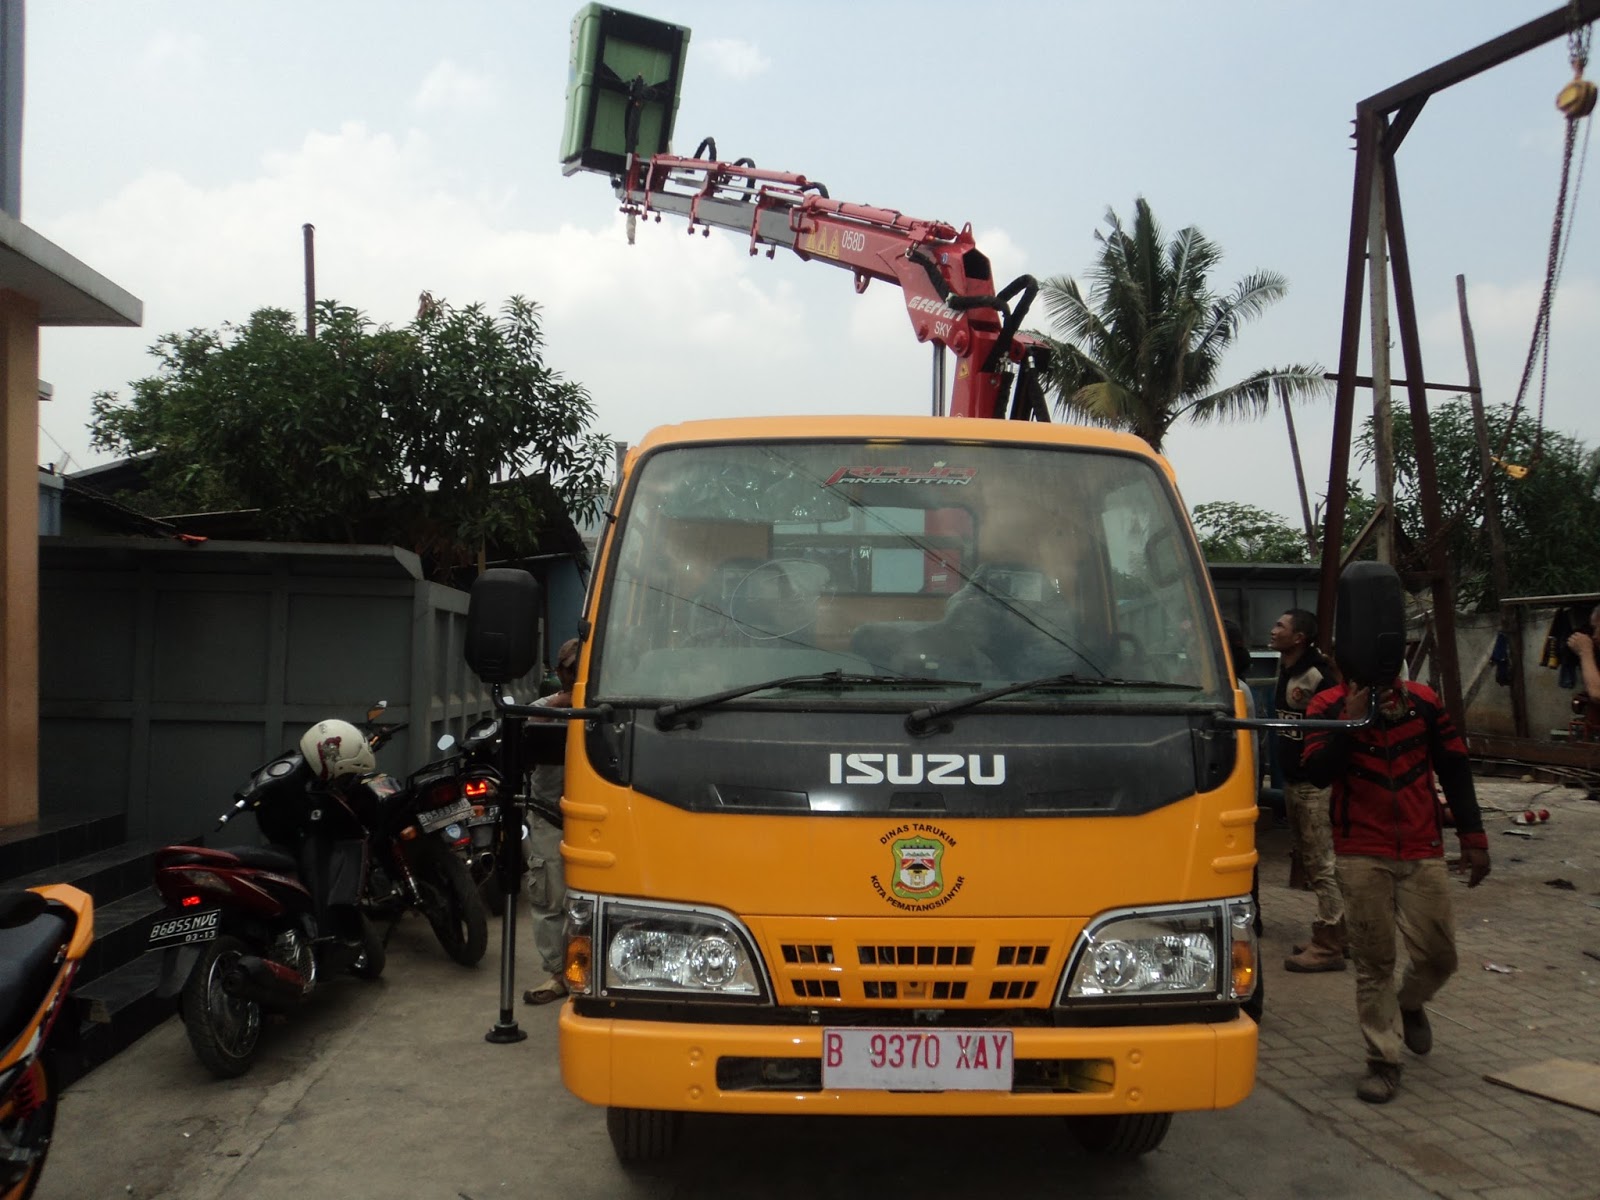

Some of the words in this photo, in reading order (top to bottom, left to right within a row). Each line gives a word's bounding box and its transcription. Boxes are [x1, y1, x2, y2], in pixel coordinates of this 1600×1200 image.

[842, 230, 865, 251] 058D
[934, 320, 952, 338] SKY
[838, 477, 972, 486] ANGKUTAN
[829, 753, 1006, 786] ISUZU
[879, 824, 910, 845] DINAS
[912, 823, 957, 847] TARUKIM
[870, 875, 886, 899] KOTA
[886, 876, 966, 912] PEMATANGSIANTAR
[827, 1033, 843, 1067] B
[870, 1034, 941, 1068] 9370
[956, 1034, 1008, 1069] XAY
